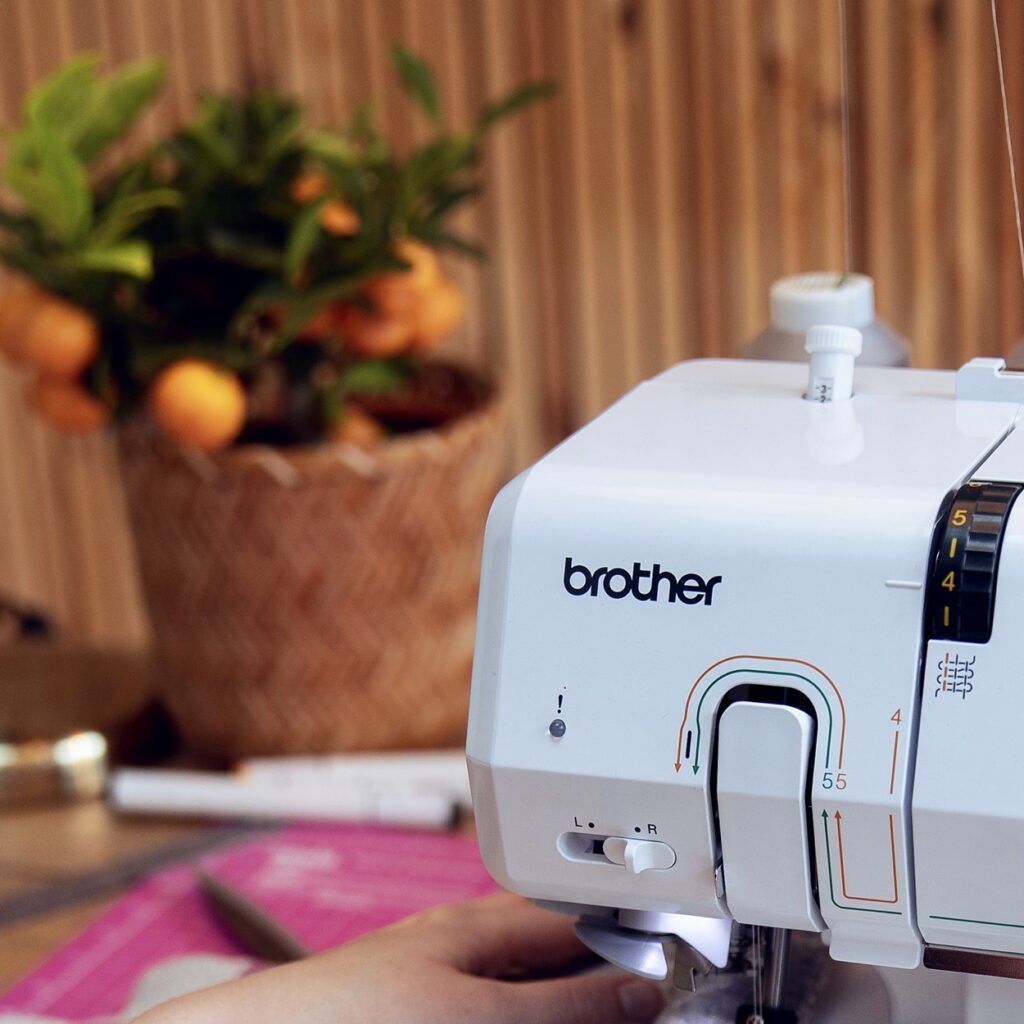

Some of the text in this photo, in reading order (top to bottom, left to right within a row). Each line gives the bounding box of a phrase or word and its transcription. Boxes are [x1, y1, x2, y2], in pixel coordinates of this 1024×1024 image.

[820, 384, 827, 395] 3
[952, 510, 967, 526] 5
[564, 557, 722, 605] brother
[941, 571, 955, 591] 4
[890, 708, 902, 725] 4
[574, 816, 658, 835] L R
